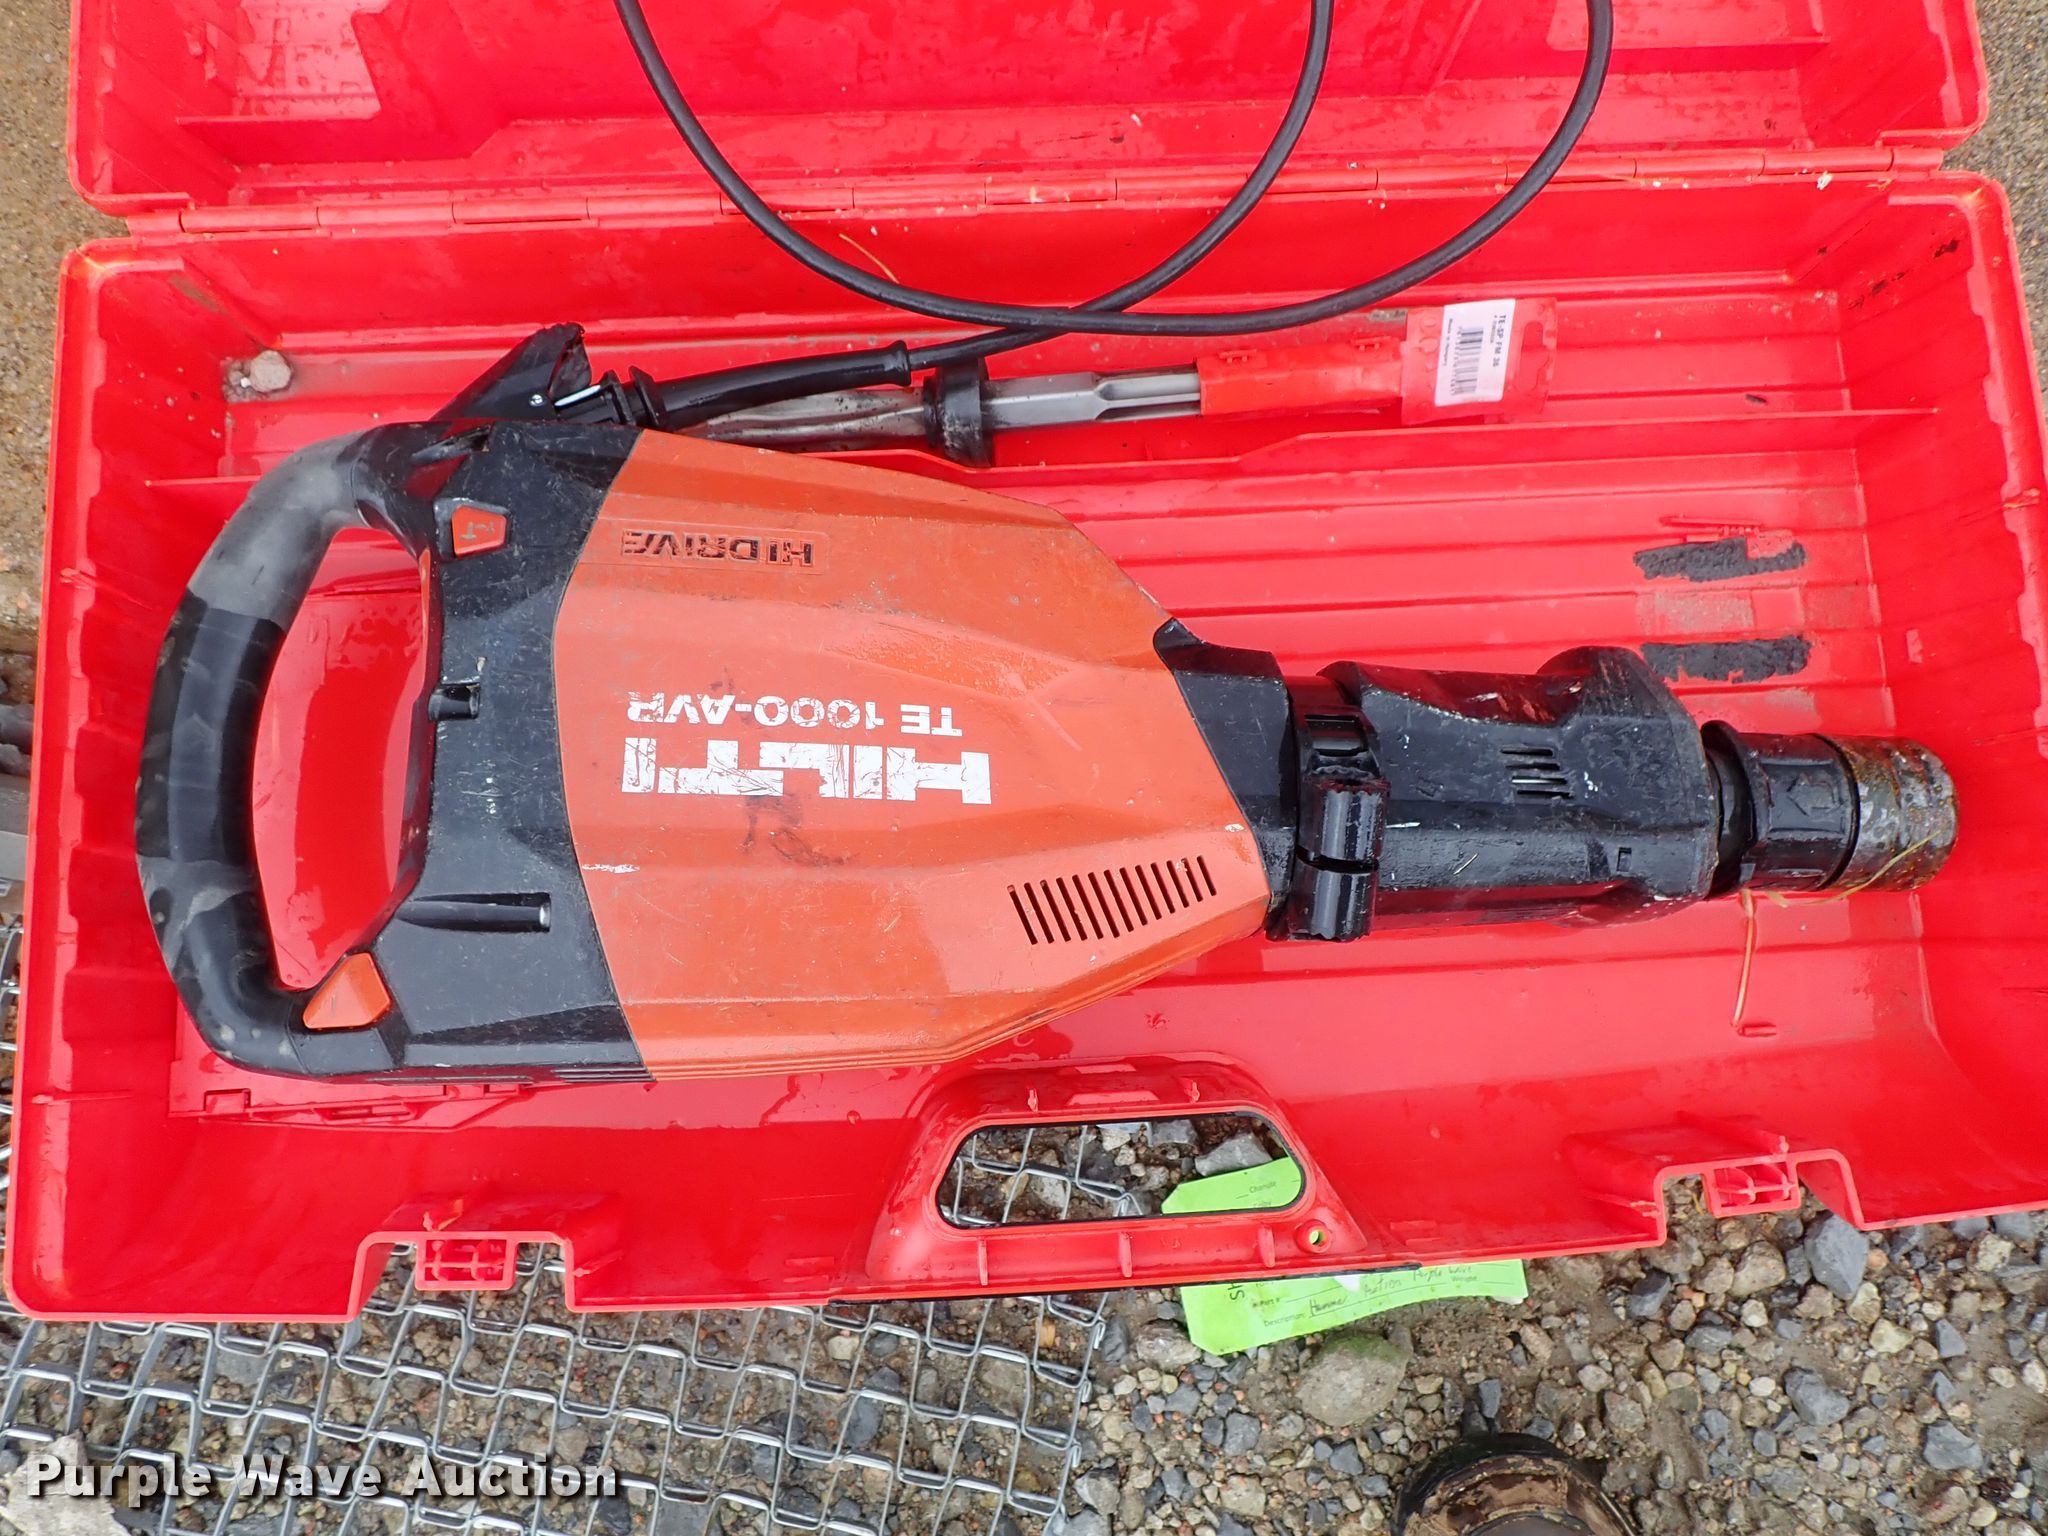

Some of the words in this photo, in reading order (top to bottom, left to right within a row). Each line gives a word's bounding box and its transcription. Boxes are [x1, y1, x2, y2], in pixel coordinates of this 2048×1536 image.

[621, 529, 761, 563] DRIVE
[765, 539, 813, 567] HI
[627, 691, 885, 730] 1000-AVR
[900, 703, 963, 737] TE
[621, 736, 992, 805] HILTI
